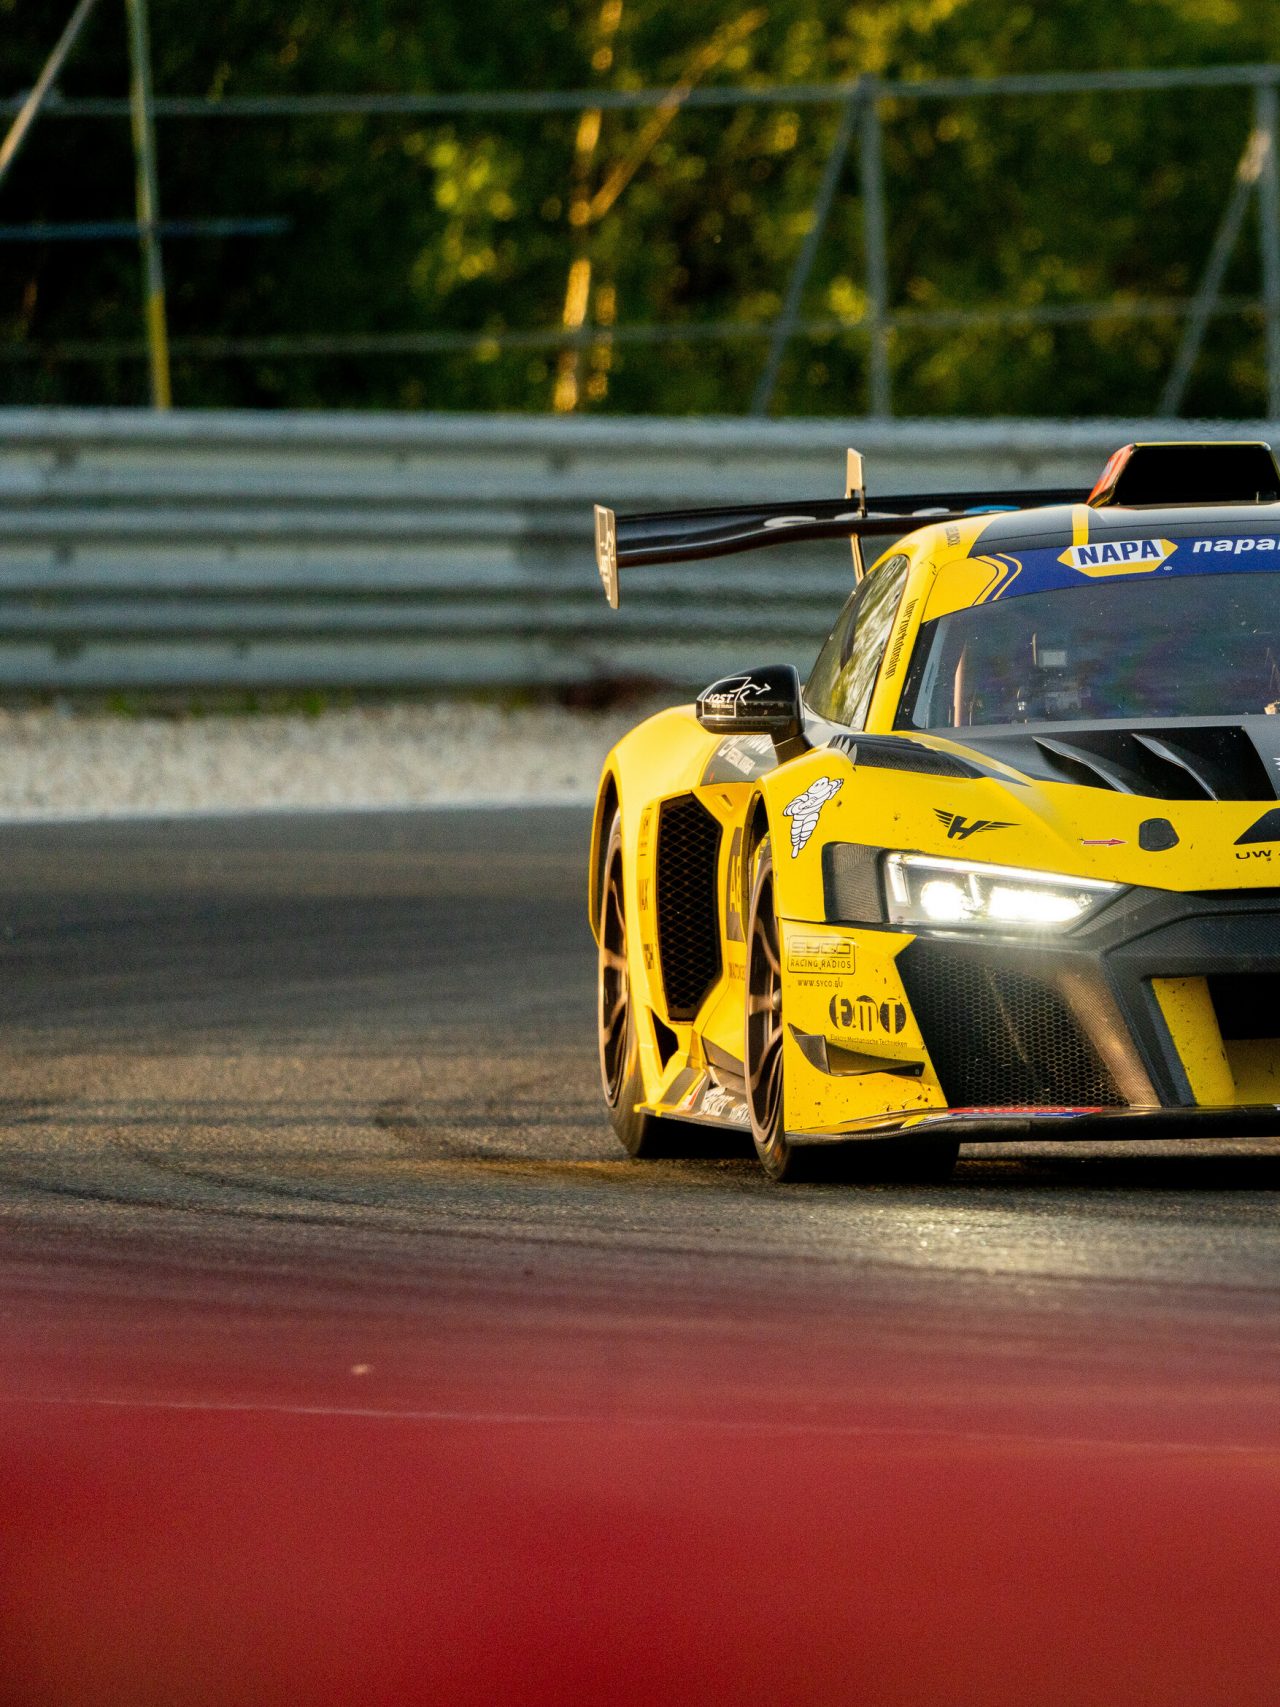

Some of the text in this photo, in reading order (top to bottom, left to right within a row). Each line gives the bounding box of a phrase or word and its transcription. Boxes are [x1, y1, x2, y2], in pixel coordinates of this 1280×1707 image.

[1077, 540, 1160, 565] NAPA
[704, 693, 735, 704] JOST
[1235, 849, 1272, 860] UW
[791, 942, 851, 955] SYCO
[790, 959, 851, 969] RACING RADIOS
